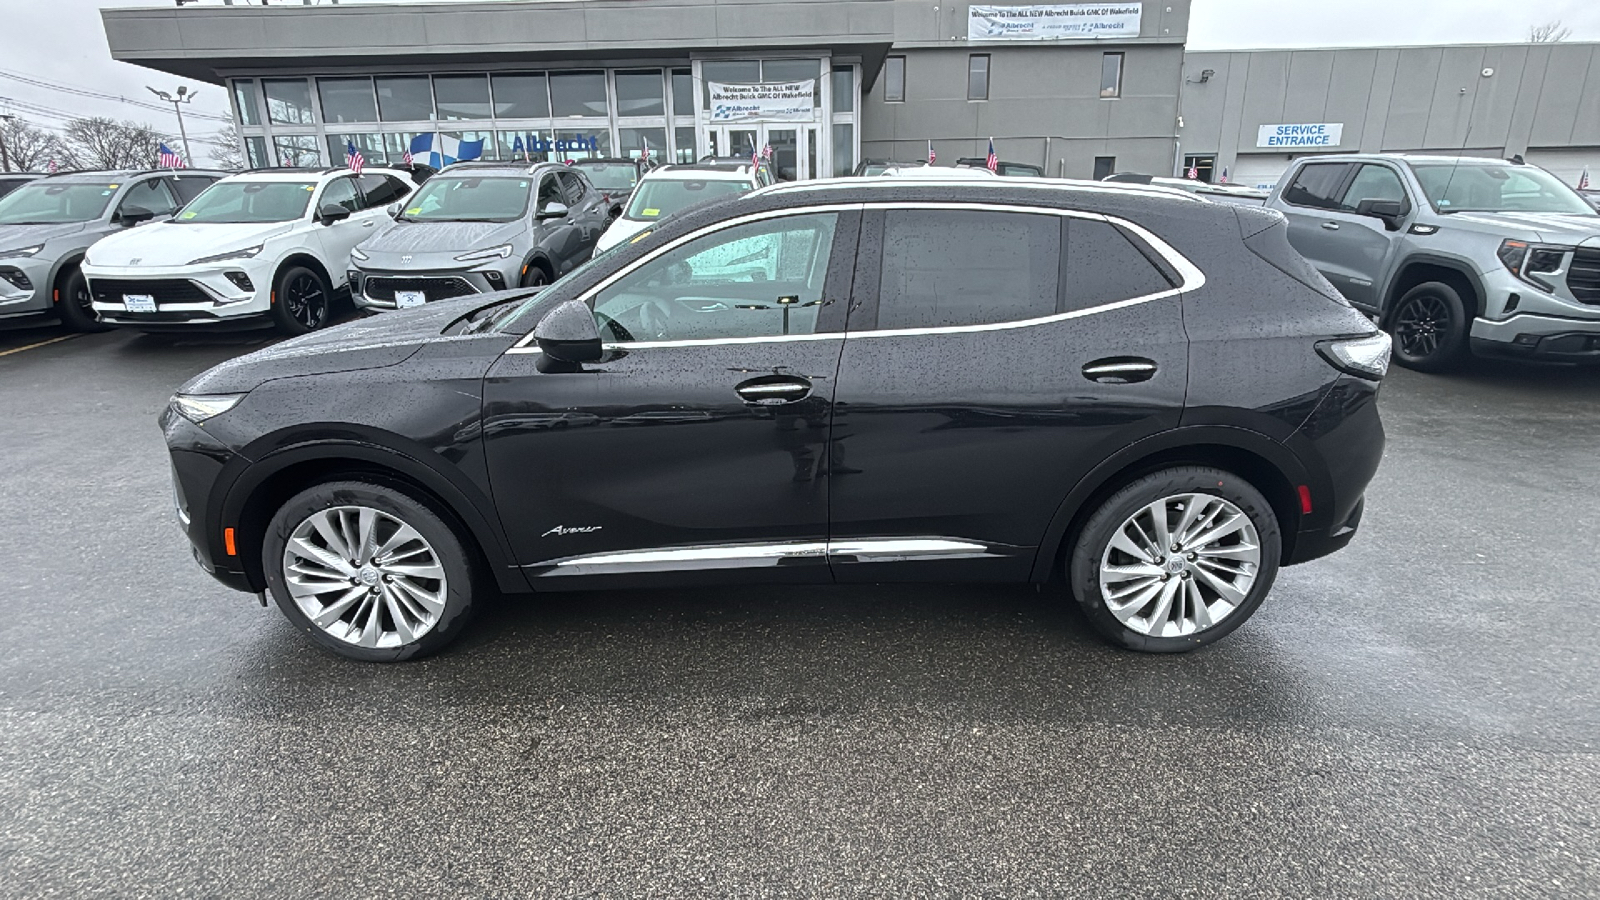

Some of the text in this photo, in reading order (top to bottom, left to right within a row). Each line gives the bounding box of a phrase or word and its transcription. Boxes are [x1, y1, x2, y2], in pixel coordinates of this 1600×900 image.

[999, 10, 1005, 18] To
[1006, 10, 1017, 18] The
[1018, 10, 1029, 18] ALL
[1030, 9, 1044, 17] NEW
[1044, 9, 1069, 17] Albrecht
[1087, 8, 1101, 16] GMC
[1110, 7, 1139, 15] Wakefield
[712, 93, 739, 101] Albrecht
[781, 91, 812, 99] Wakefield
[1276, 125, 1326, 136] SERVICE
[512, 133, 598, 153] Albrecht
[1268, 135, 1330, 146] ENTRANCE
